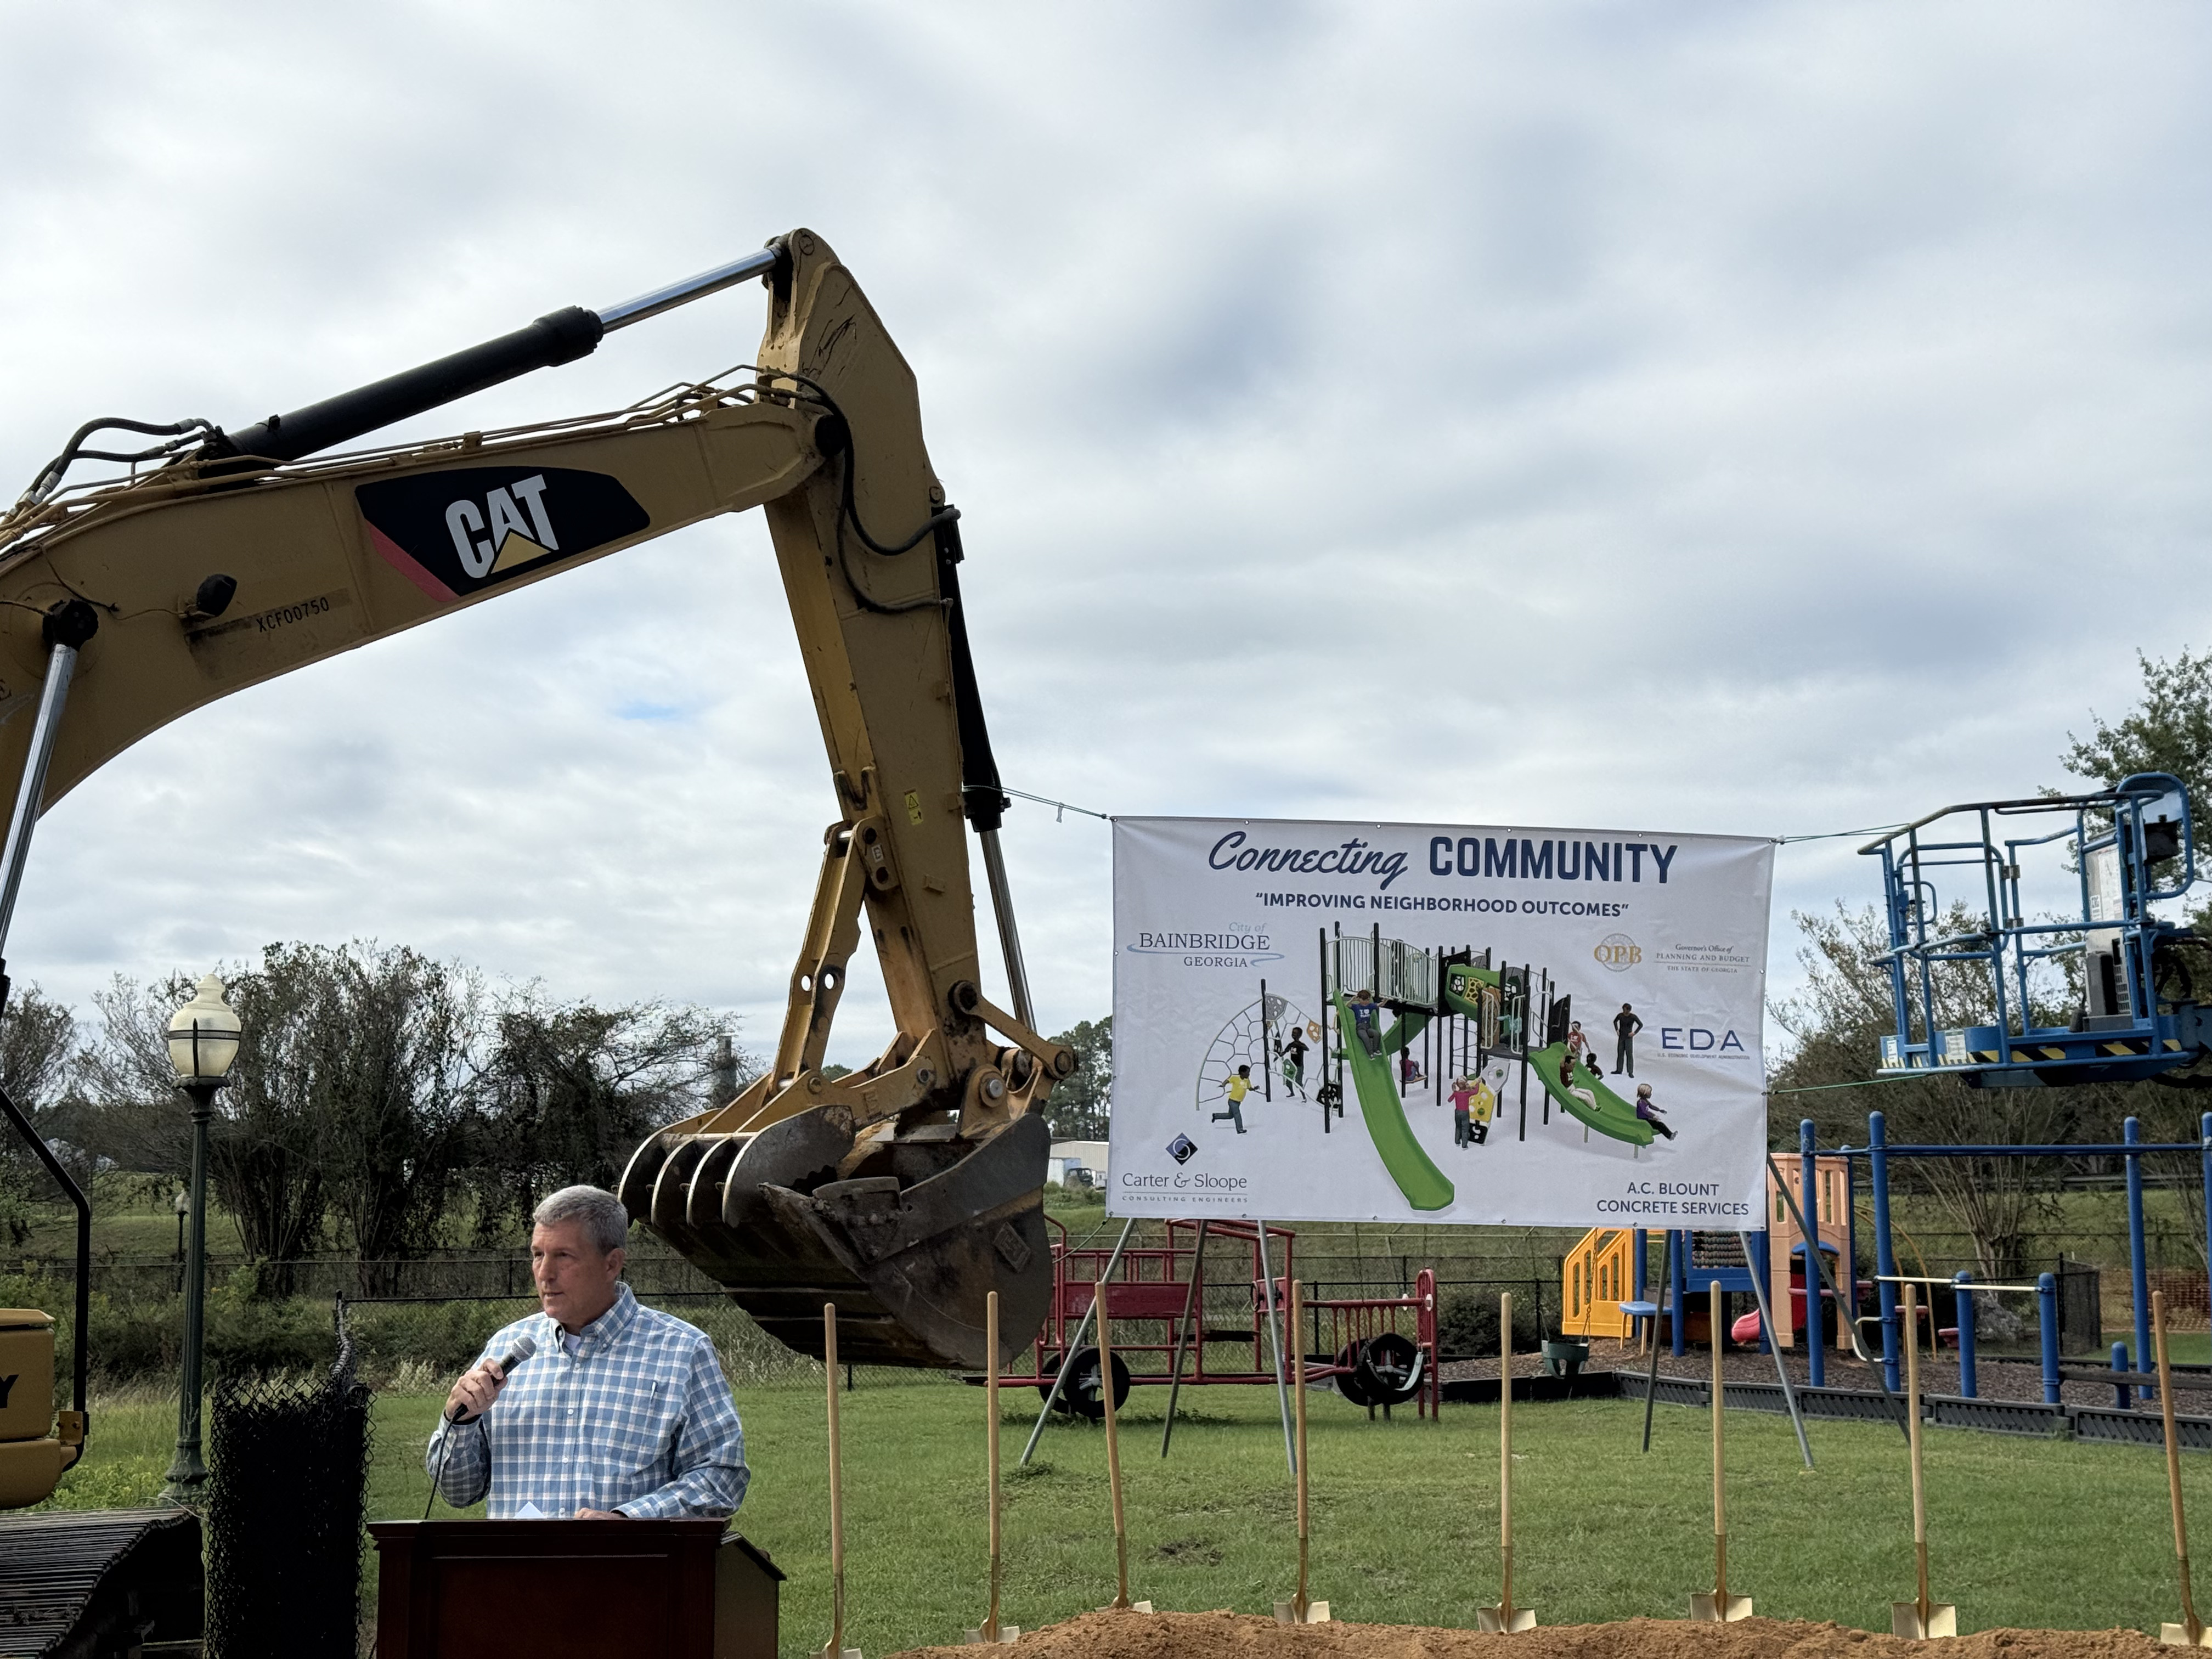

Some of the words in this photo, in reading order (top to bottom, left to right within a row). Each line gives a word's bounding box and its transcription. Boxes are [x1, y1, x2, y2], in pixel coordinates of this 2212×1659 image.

[445, 474, 559, 578] CAT
[256, 597, 329, 633] XCF00750
[1209, 831, 1408, 890] Connecting
[1430, 837, 1678, 883] COMMUNITY
[1370, 895, 1517, 913] NEIGHBORHOOD
[1229, 922, 1251, 933] City
[1254, 923, 1267, 933] of
[1139, 933, 1271, 950] BAINBRIDGE
[1726, 945, 1734, 955] of
[1184, 956, 1248, 967] GEORGIA
[1594, 945, 1642, 964] OPB
[1122, 1172, 1169, 1187] Carter
[1174, 1172, 1191, 1188] &
[1194, 1173, 1248, 1191] Sloope
[1627, 1182, 1655, 1195] A.C.
[1659, 1183, 1719, 1196] BLOUNT
[1597, 1200, 1678, 1214] CONCRETE
[1681, 1201, 1750, 1215] SERVICES
